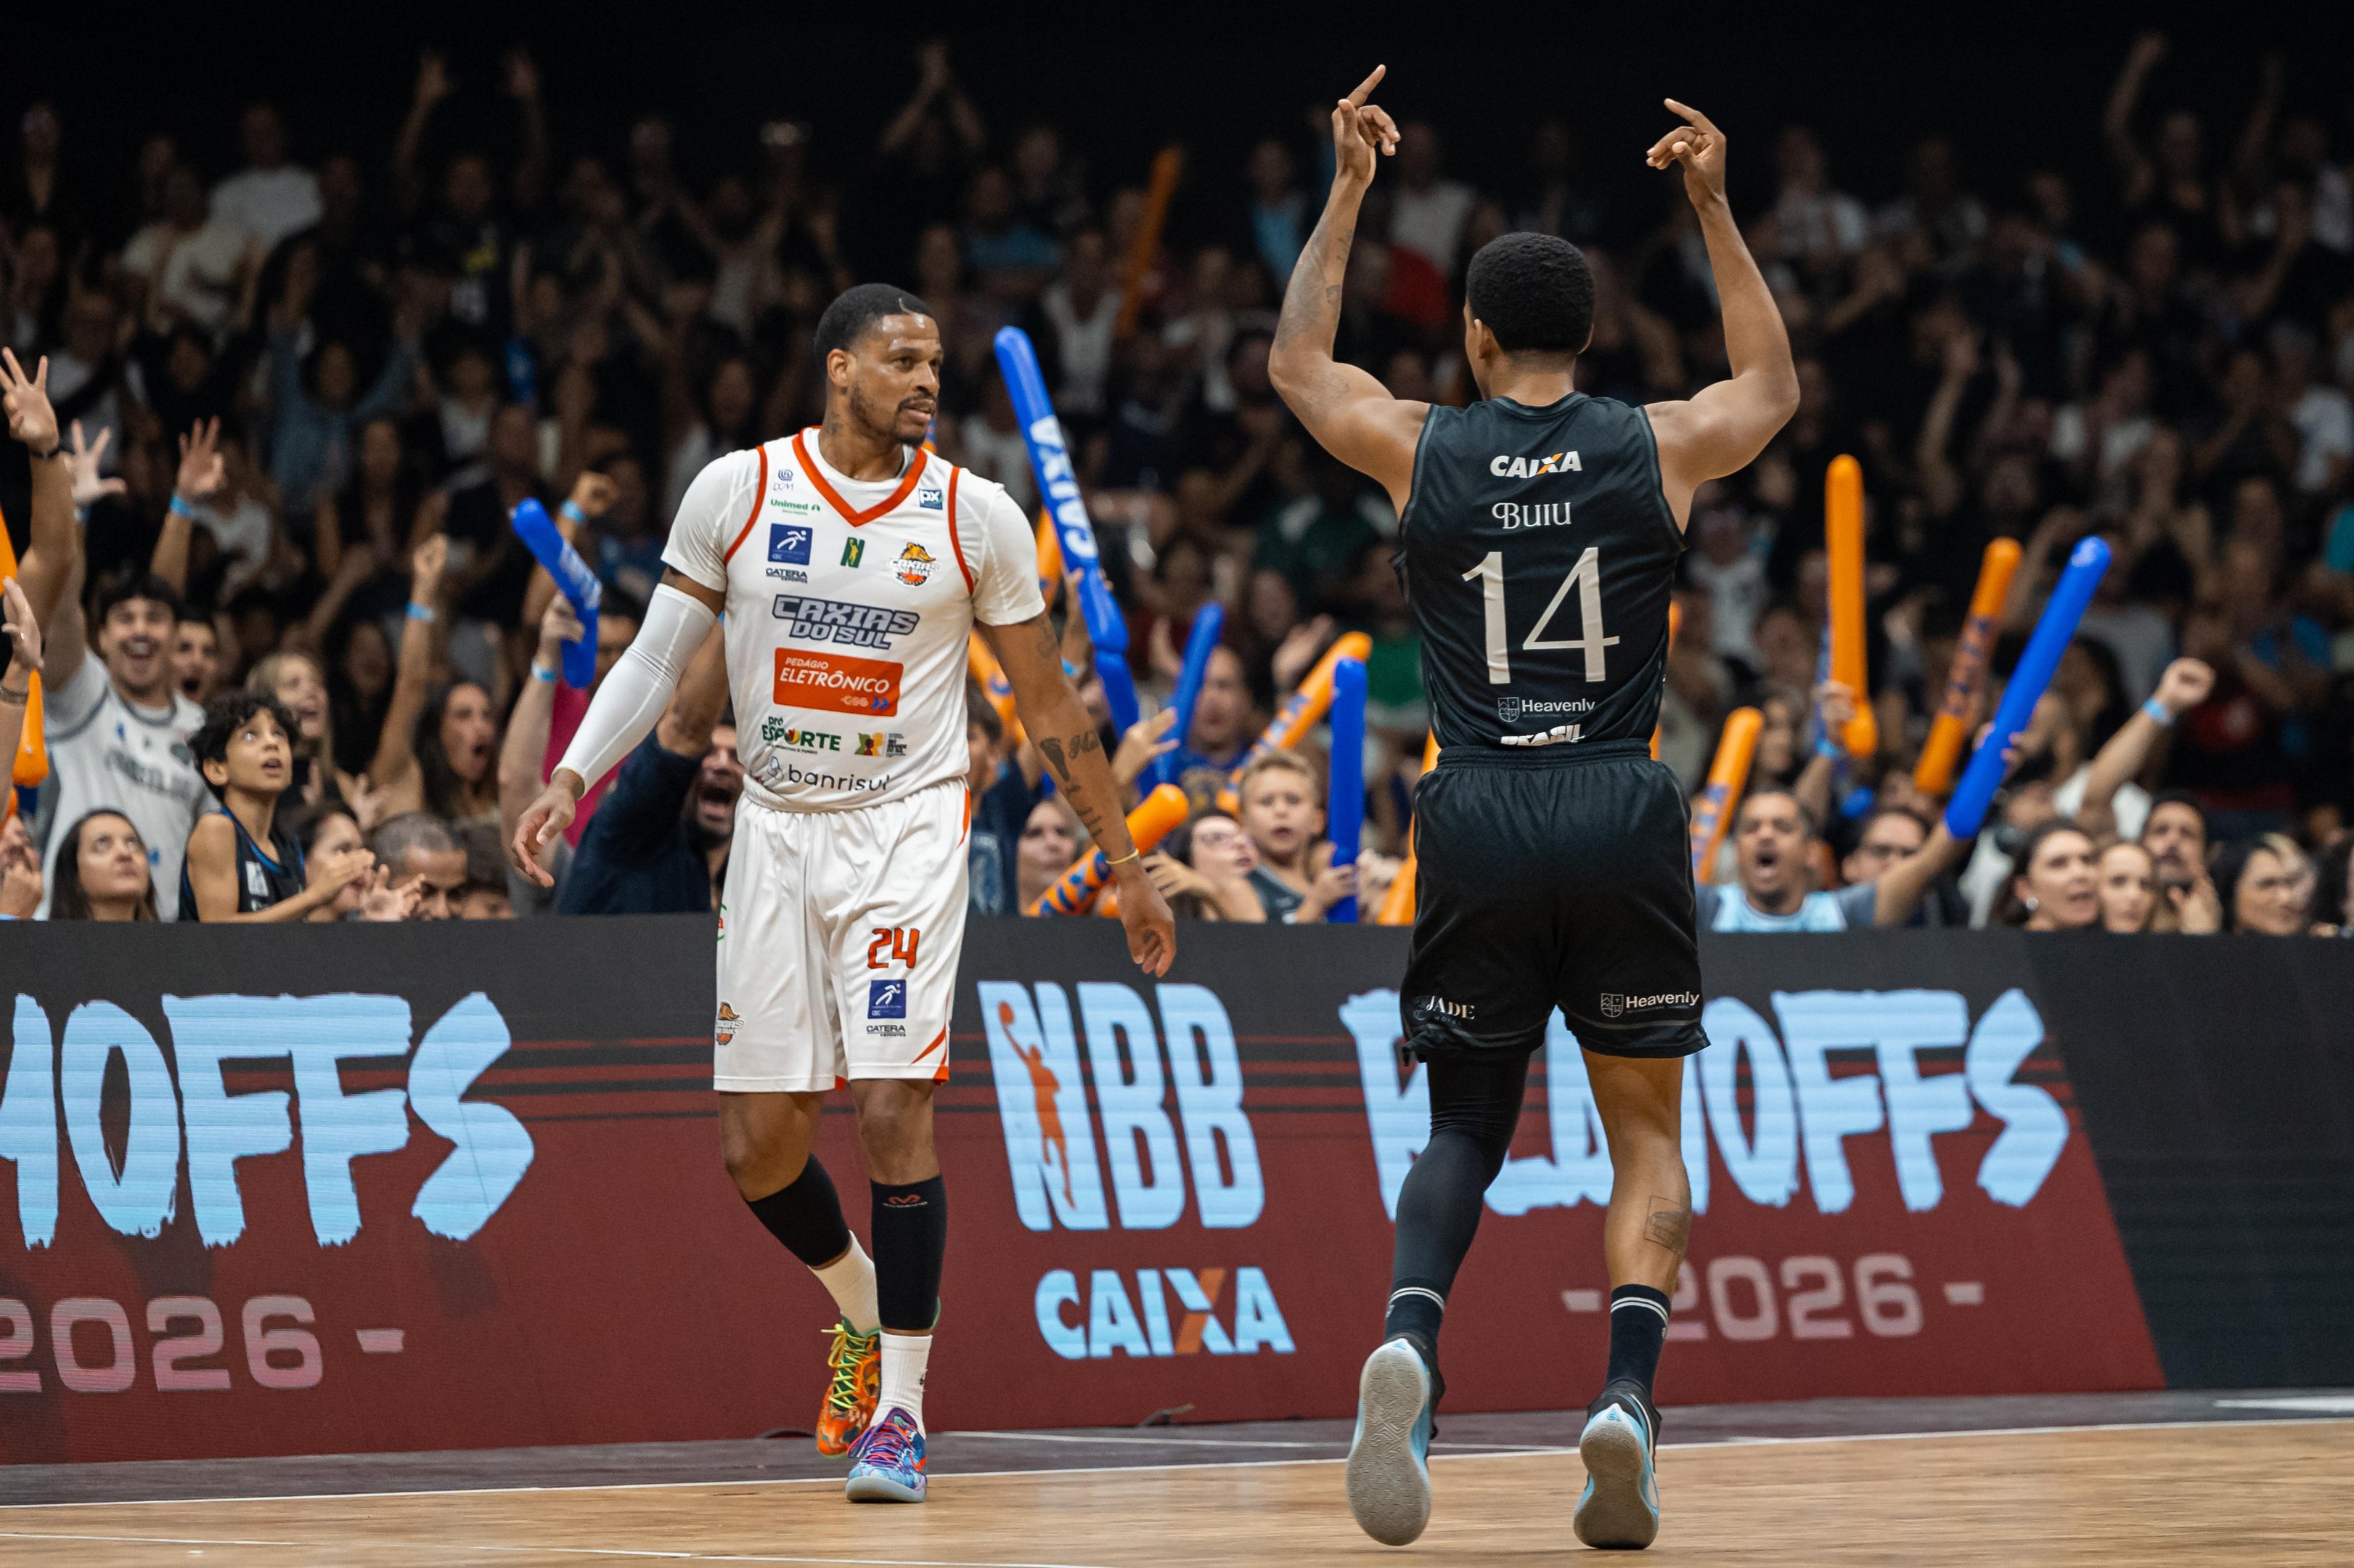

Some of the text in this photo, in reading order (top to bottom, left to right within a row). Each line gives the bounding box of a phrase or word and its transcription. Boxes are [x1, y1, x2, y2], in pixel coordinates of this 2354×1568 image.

[1489, 450, 1583, 478] CAIXA
[770, 498, 809, 510] Unimed
[920, 489, 941, 505] px
[772, 594, 920, 635] CAXIAS
[1461, 546, 1621, 685] 14
[788, 620, 892, 650] DO SUL
[785, 656, 830, 670] PEDÁGIO
[780, 667, 891, 694] ELETRÔNICO
[1521, 698, 1596, 712] Heavenly
[768, 716, 784, 727] pró
[761, 724, 842, 752] ESPORTE
[788, 763, 891, 791] banrisul
[867, 926, 920, 969] 24
[1426, 995, 1475, 1020] JADE
[1625, 990, 1700, 1008] Heavenly
[977, 981, 1265, 1231] NBB
[1034, 1267, 1296, 1360] CAIXA
